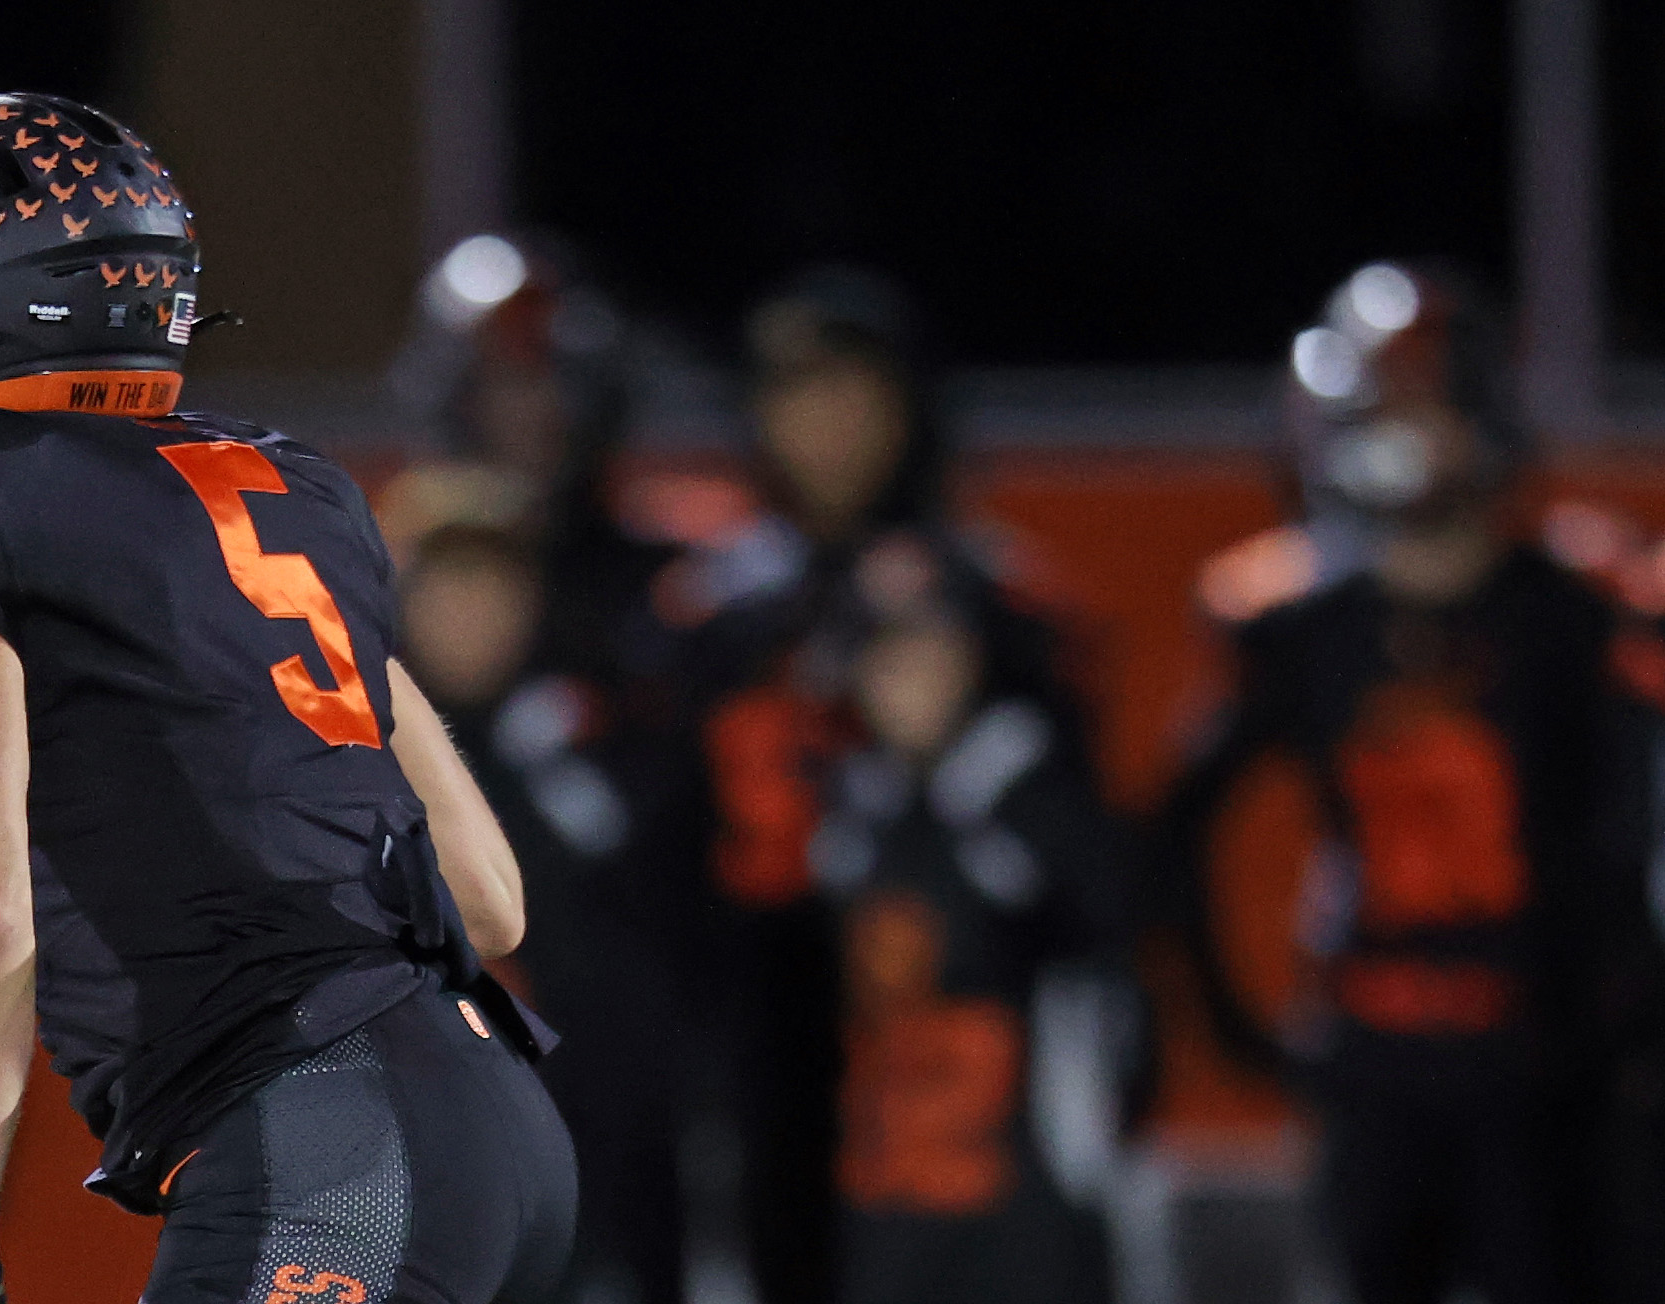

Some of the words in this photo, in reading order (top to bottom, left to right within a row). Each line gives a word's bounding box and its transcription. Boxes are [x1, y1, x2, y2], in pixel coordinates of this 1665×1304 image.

[70, 382, 108, 408] WIN
[115, 383, 145, 408] THE
[156, 441, 382, 750] 5
